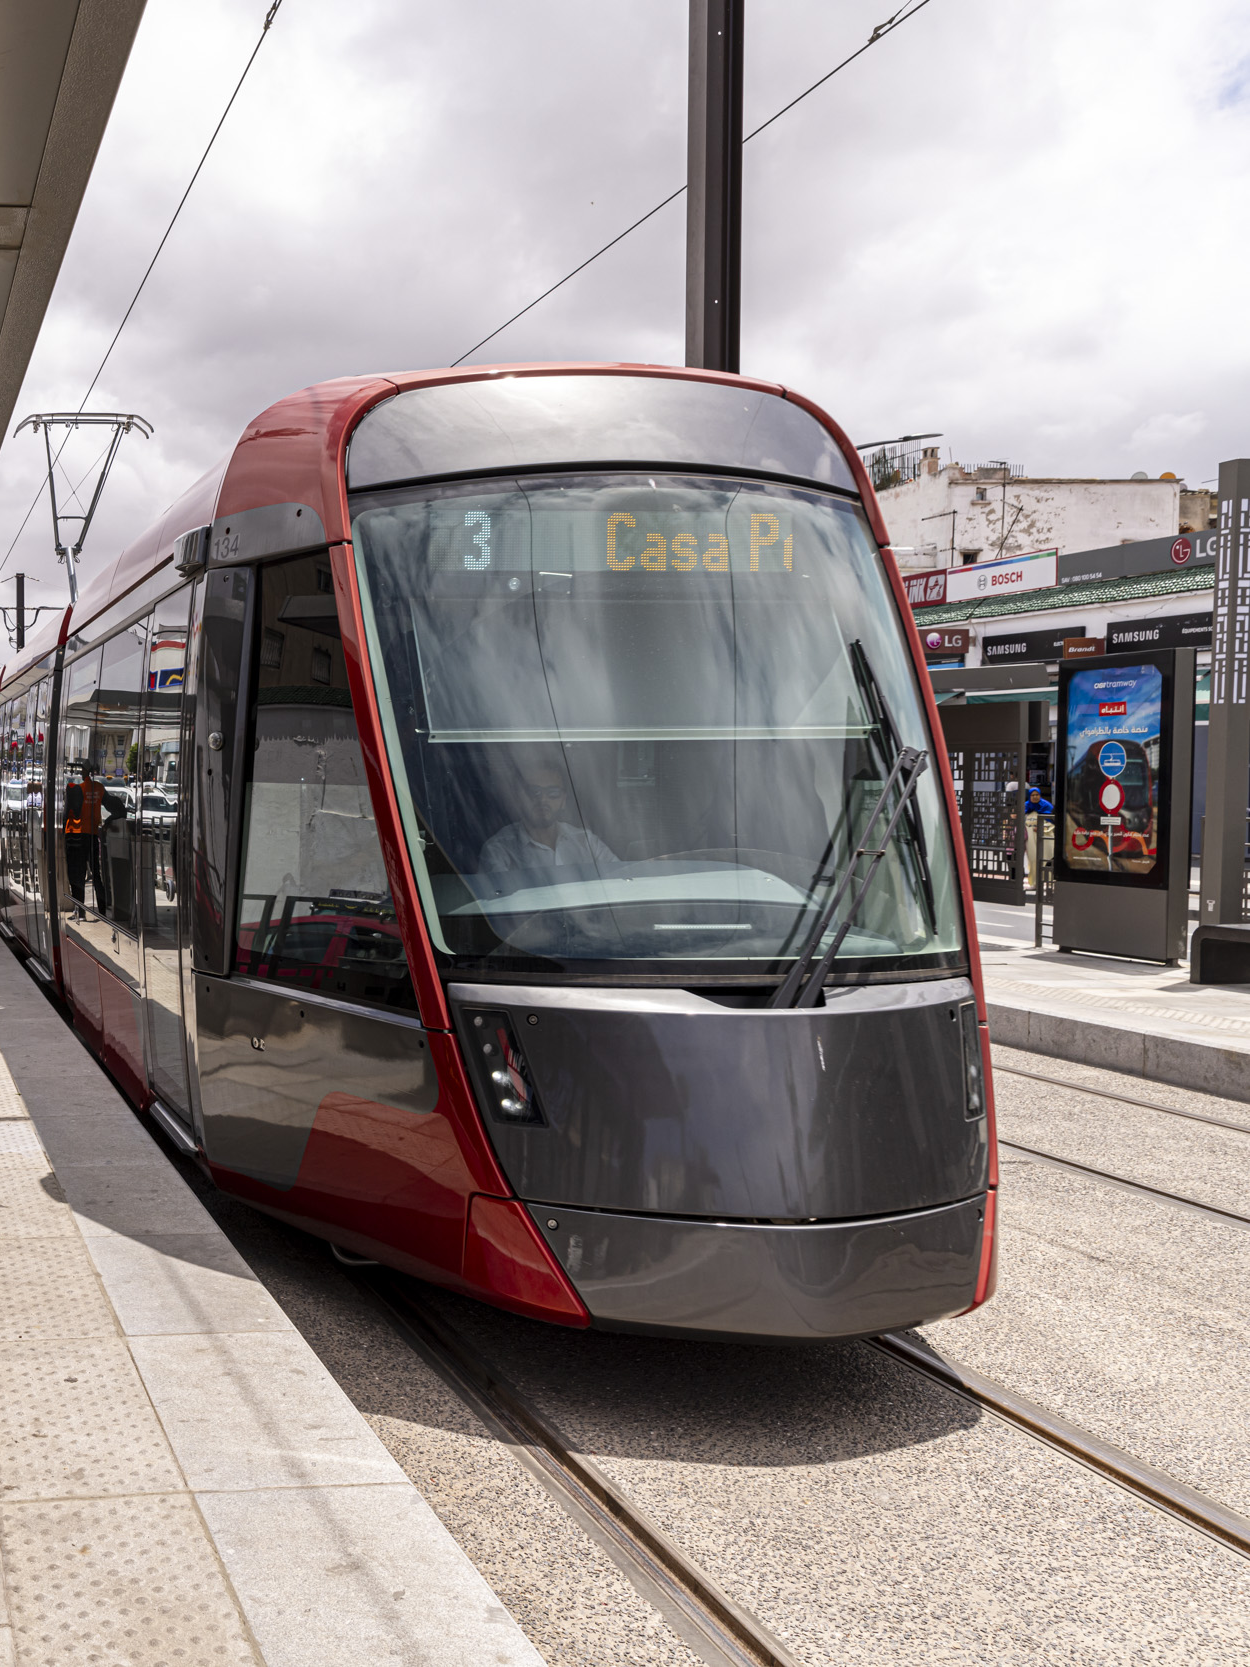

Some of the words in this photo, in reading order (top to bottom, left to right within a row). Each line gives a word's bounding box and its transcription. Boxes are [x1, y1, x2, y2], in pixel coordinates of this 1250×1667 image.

[214, 534, 239, 560] 134
[463, 510, 491, 571] 3
[606, 512, 730, 571] Casa
[991, 570, 1023, 587] BOSCH
[944, 634, 962, 647] LG
[1112, 629, 1160, 645] SAMSUNG
[986, 642, 1027, 656] SAMSUNG
[1068, 645, 1096, 653] Brandt
